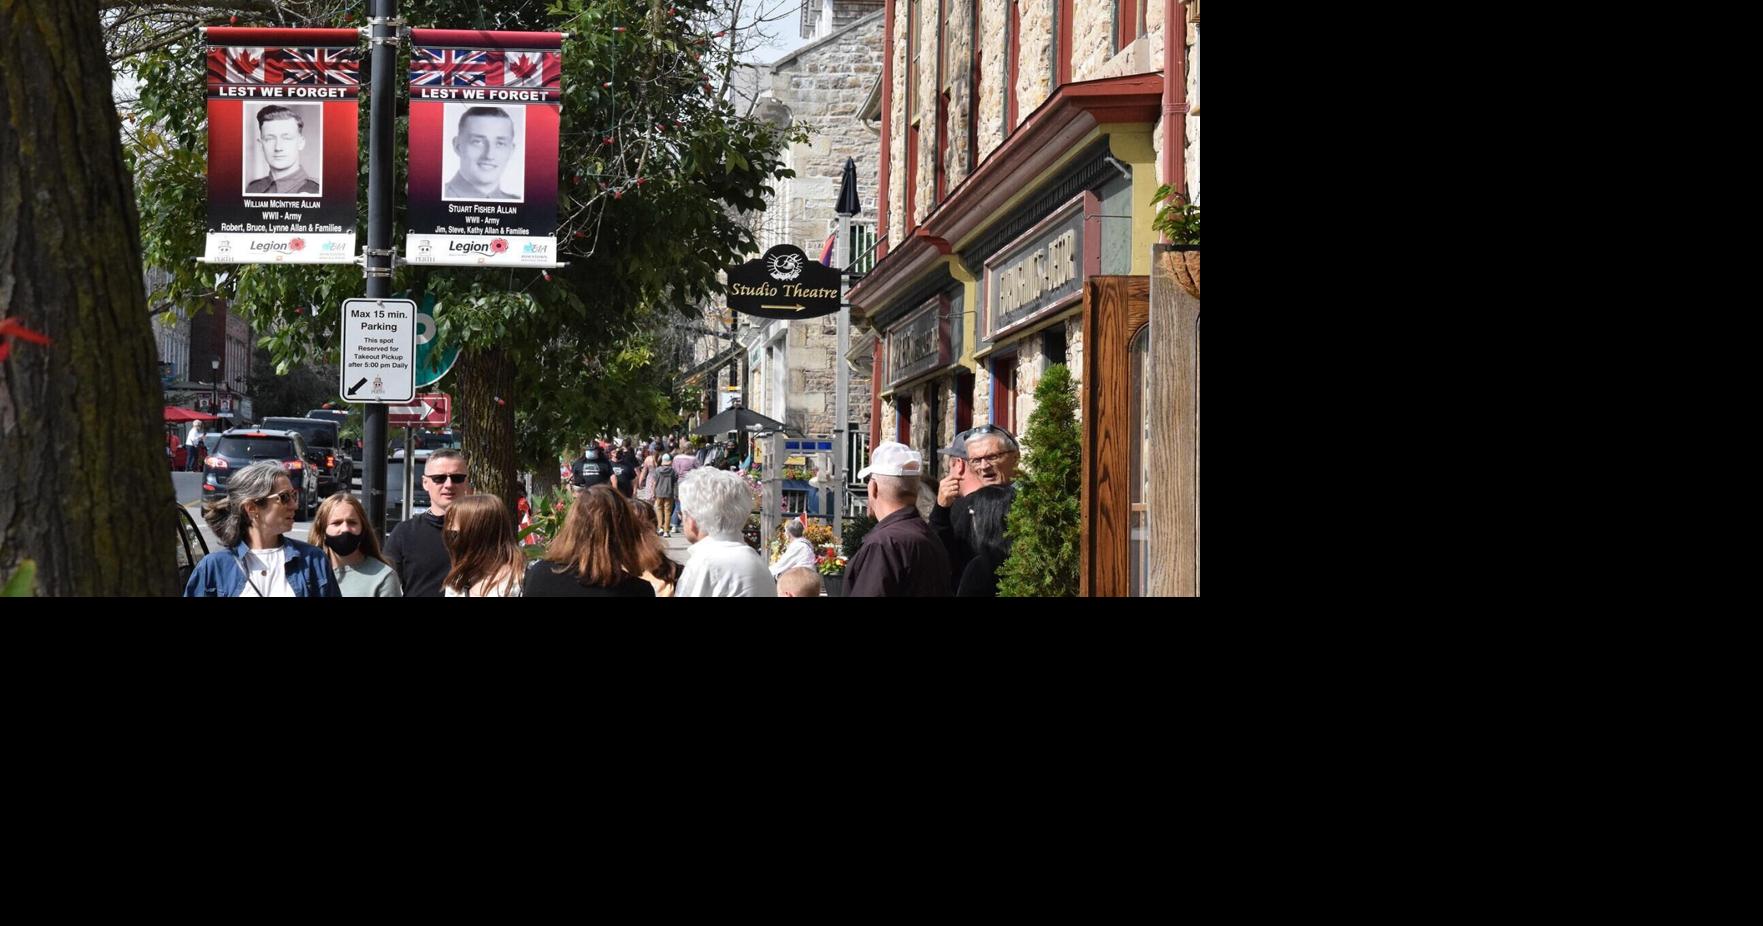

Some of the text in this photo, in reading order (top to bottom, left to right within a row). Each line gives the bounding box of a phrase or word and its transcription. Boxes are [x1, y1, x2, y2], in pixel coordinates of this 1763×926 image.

[219, 86, 347, 98] LEST WE FORGET
[421, 88, 549, 100] LEST WE FORGET
[244, 200, 268, 208] WILLIAM
[300, 200, 320, 208] ALLAN
[448, 204, 517, 214] STUART FISHER ALLAN
[284, 212, 302, 222] Army
[484, 216, 500, 224] Army
[221, 223, 245, 232] Robert,
[246, 224, 268, 232] Bruce,
[268, 224, 289, 234] Lynne
[314, 224, 342, 232] Families
[466, 226, 484, 235] Kathy
[250, 240, 288, 252] Legion
[449, 240, 488, 253] Legion
[732, 282, 838, 298] Studio Theatre
[351, 310, 370, 318] Max
[374, 310, 385, 318] 15
[360, 322, 398, 332] Parking
